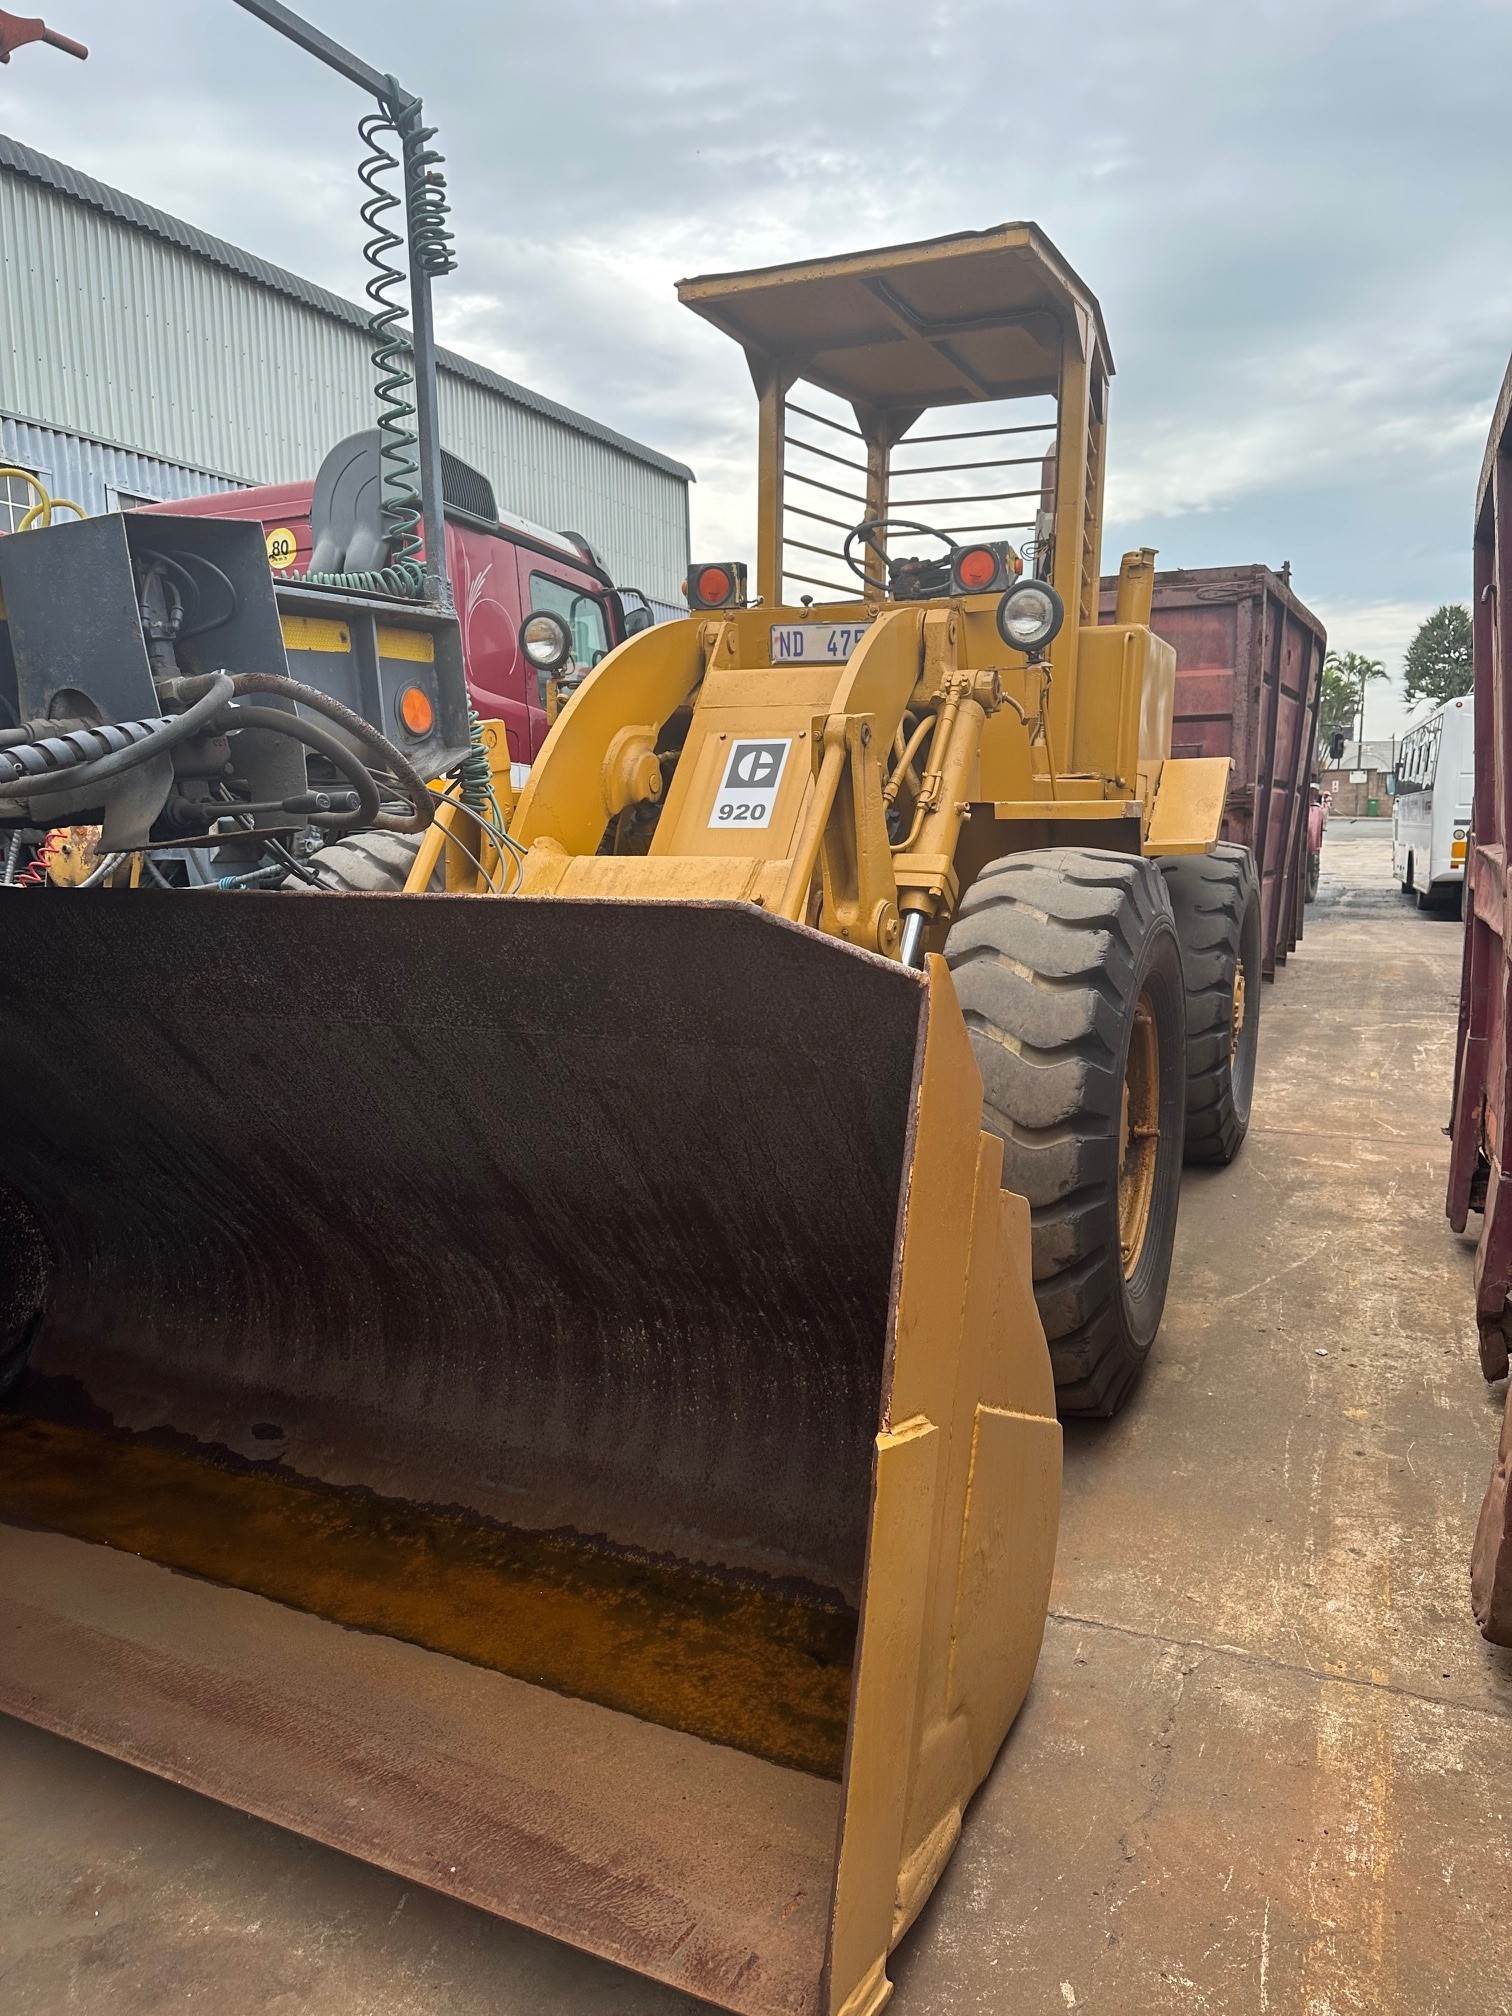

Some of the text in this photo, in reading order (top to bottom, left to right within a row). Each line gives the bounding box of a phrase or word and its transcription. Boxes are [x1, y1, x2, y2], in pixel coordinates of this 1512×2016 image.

[272, 540, 289, 556] 80
[780, 631, 804, 657] ND
[718, 804, 766, 820] 920
